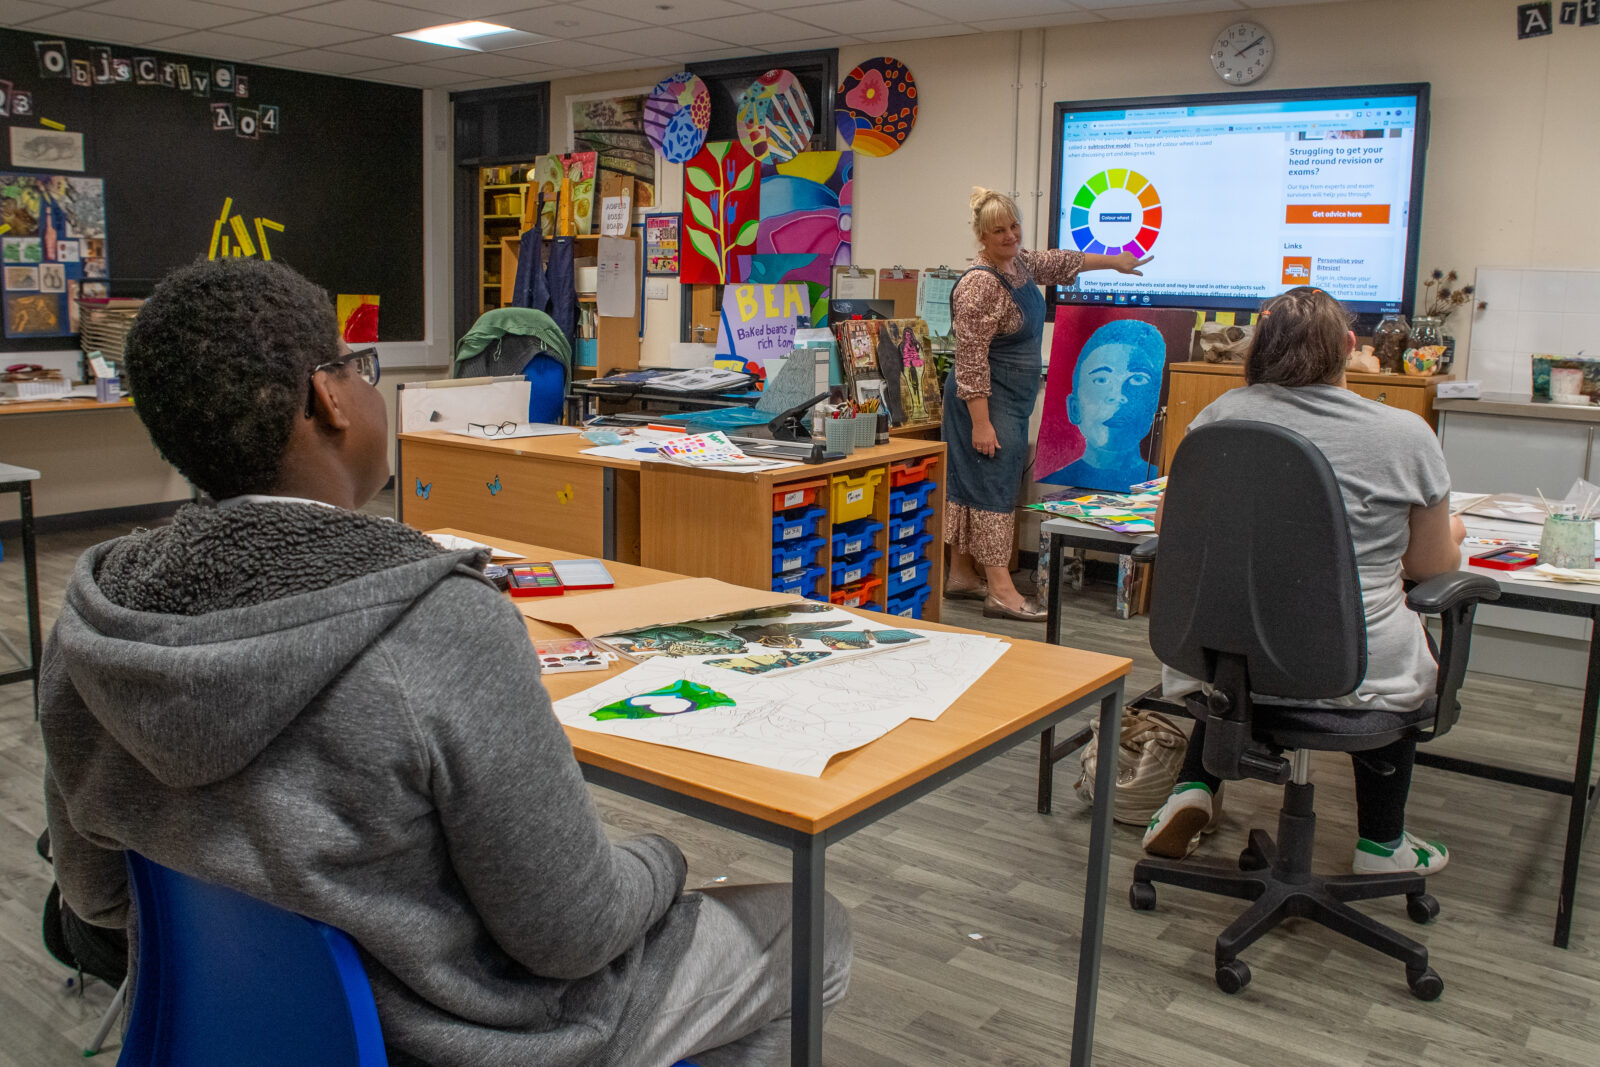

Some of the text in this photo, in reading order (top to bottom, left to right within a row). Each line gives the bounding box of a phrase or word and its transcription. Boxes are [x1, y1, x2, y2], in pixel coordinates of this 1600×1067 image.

[1290, 148, 1334, 157] Struggling
[1347, 147, 1360, 155] get
[1363, 146, 1383, 154] your
[766, 324, 787, 335] beans
[758, 336, 773, 350] rich
